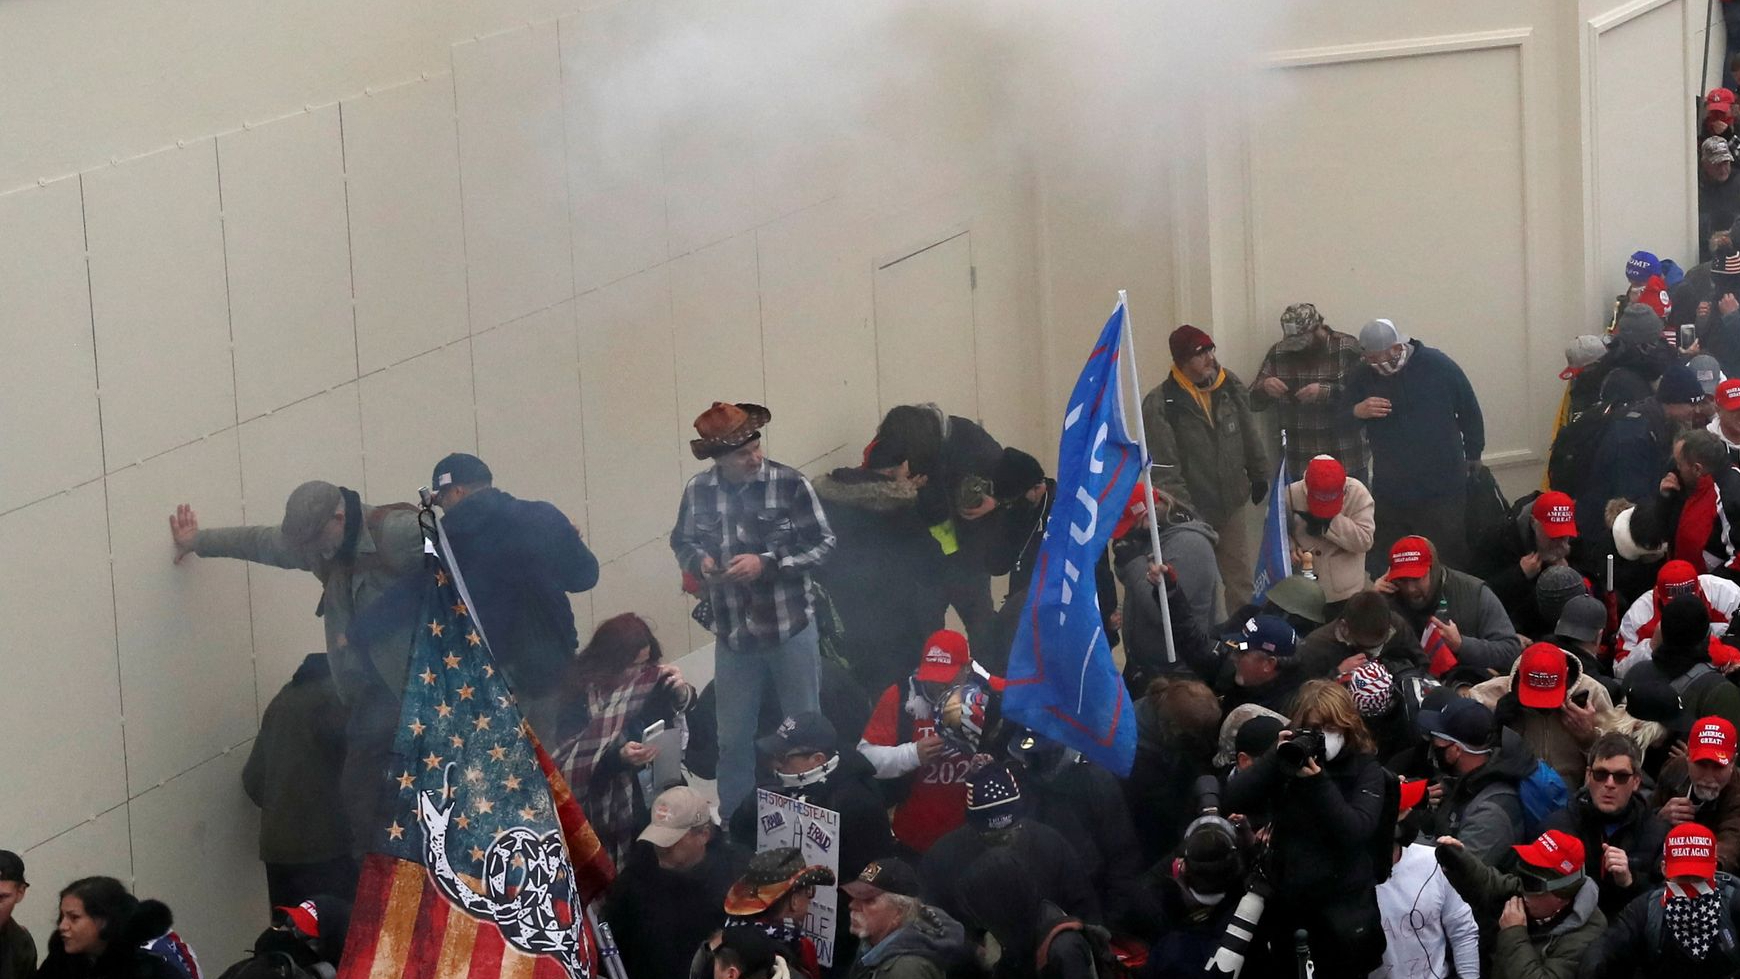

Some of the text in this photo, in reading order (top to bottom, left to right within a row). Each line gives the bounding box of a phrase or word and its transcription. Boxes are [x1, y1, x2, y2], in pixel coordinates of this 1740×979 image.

[1698, 730, 1726, 739] AMERICA
[923, 760, 971, 784] 202
[806, 822, 832, 853] FRAUD
[1668, 836, 1712, 847] MAKE AMERICA
[1671, 847, 1710, 857] GREAT AGAIN
